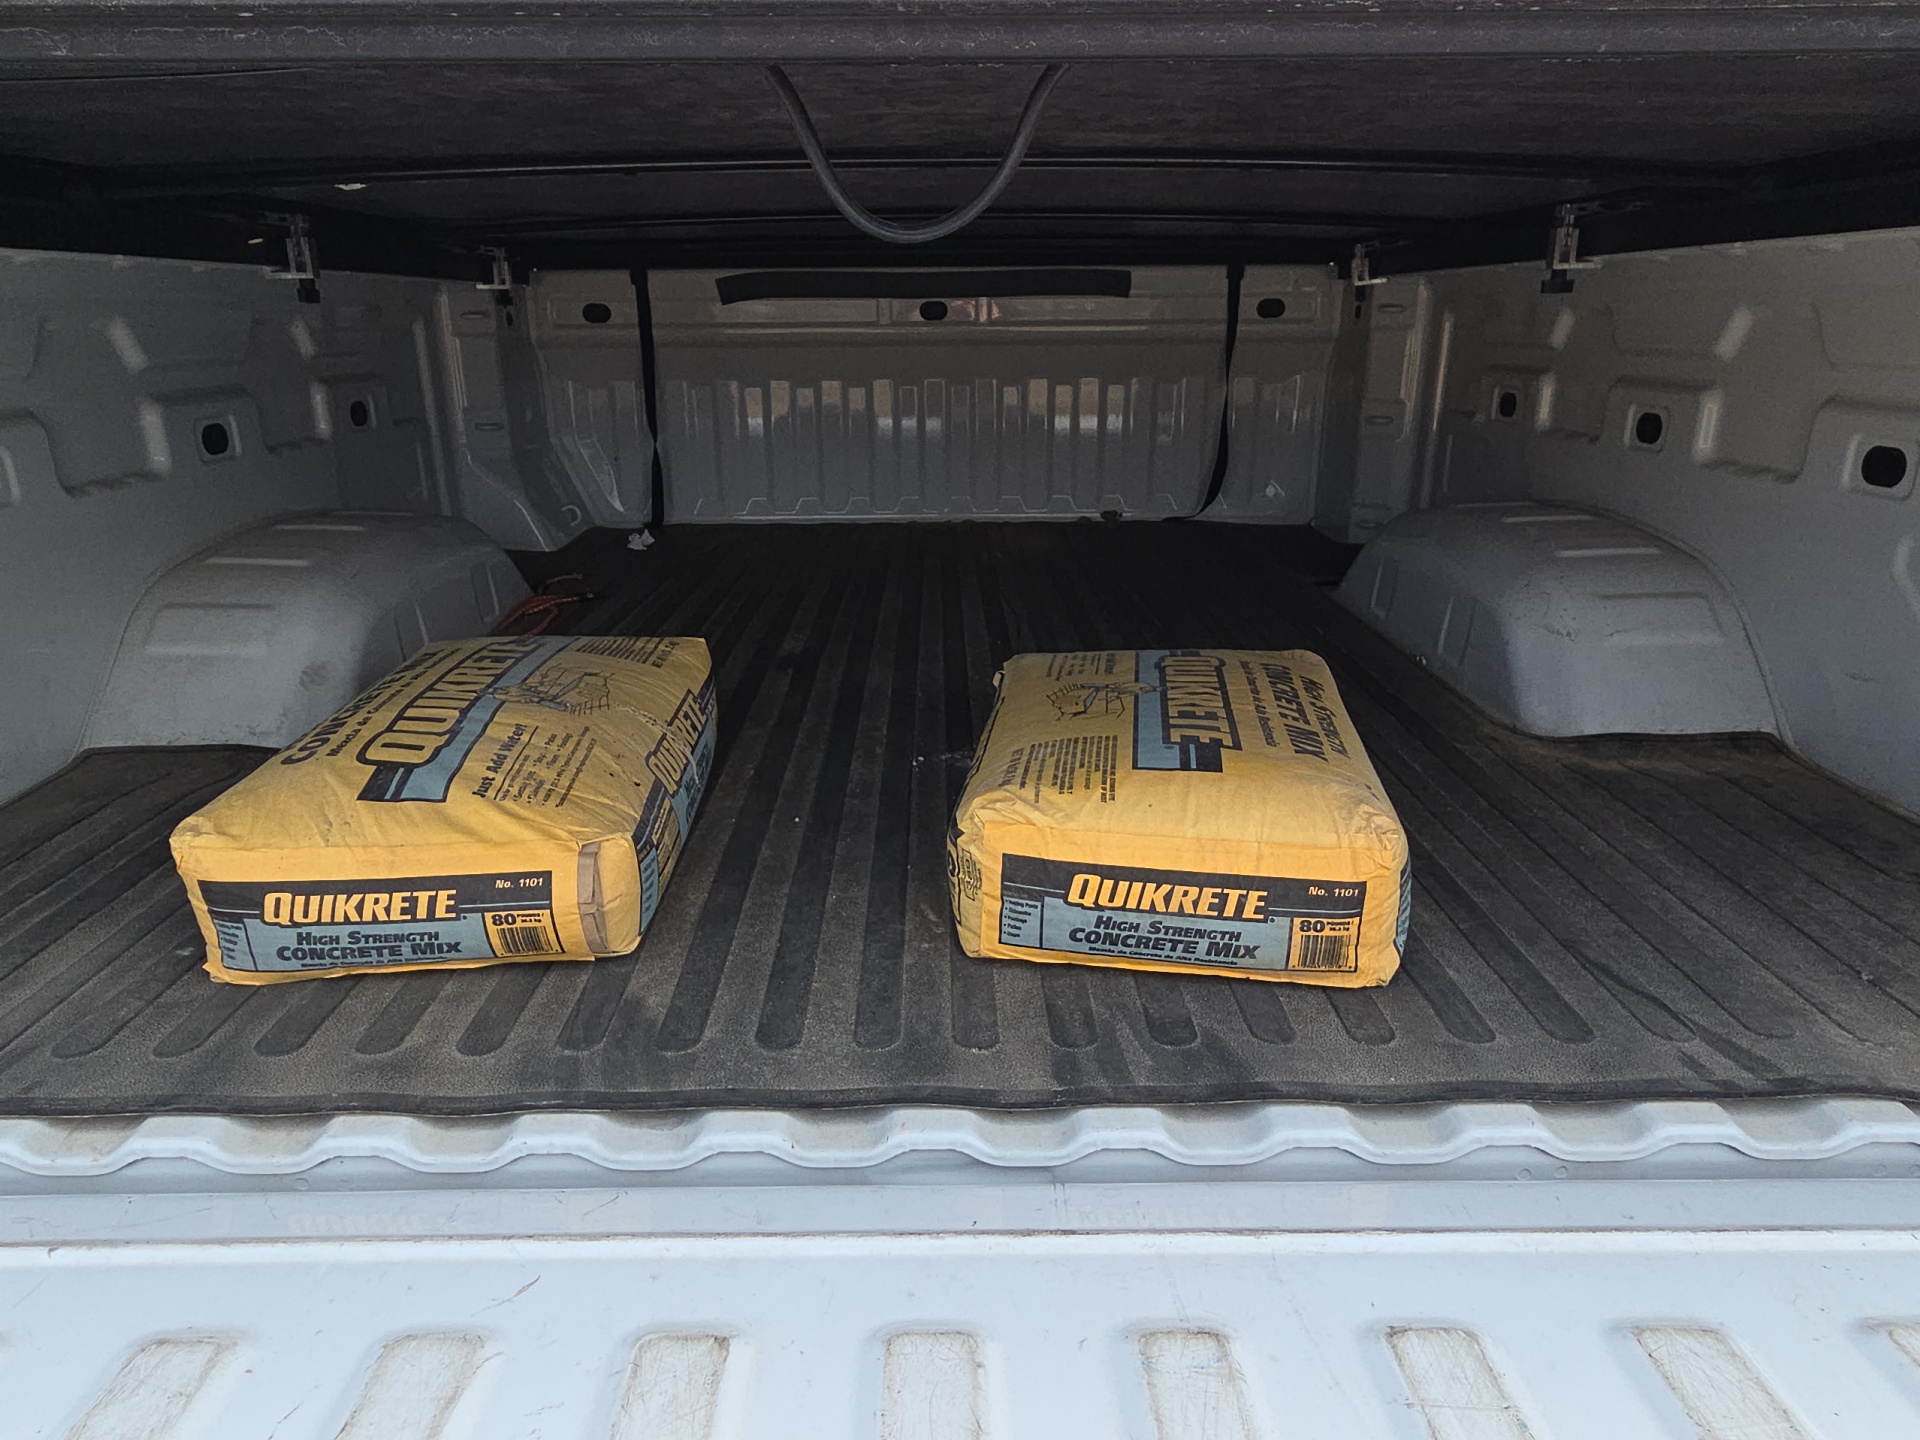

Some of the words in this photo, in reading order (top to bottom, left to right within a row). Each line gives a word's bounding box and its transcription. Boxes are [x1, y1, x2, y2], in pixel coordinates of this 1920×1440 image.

[1160, 656, 1234, 747] QUIKRETE
[472, 776, 496, 798] Just
[486, 753, 508, 774] Add
[495, 879, 514, 889] No.
[518, 878, 543, 888] 1101
[1067, 873, 1268, 919] QUIKRETE
[1308, 886, 1329, 897] No.
[1333, 888, 1359, 897] 1101
[263, 889, 457, 925] QUIKRETE
[491, 912, 517, 926] 80
[1299, 919, 1326, 933] 80
[276, 945, 403, 961] CONCRETE
[411, 941, 463, 956] MIX
[1068, 927, 1199, 954] CONCRETE
[1205, 941, 1261, 960] MIX
